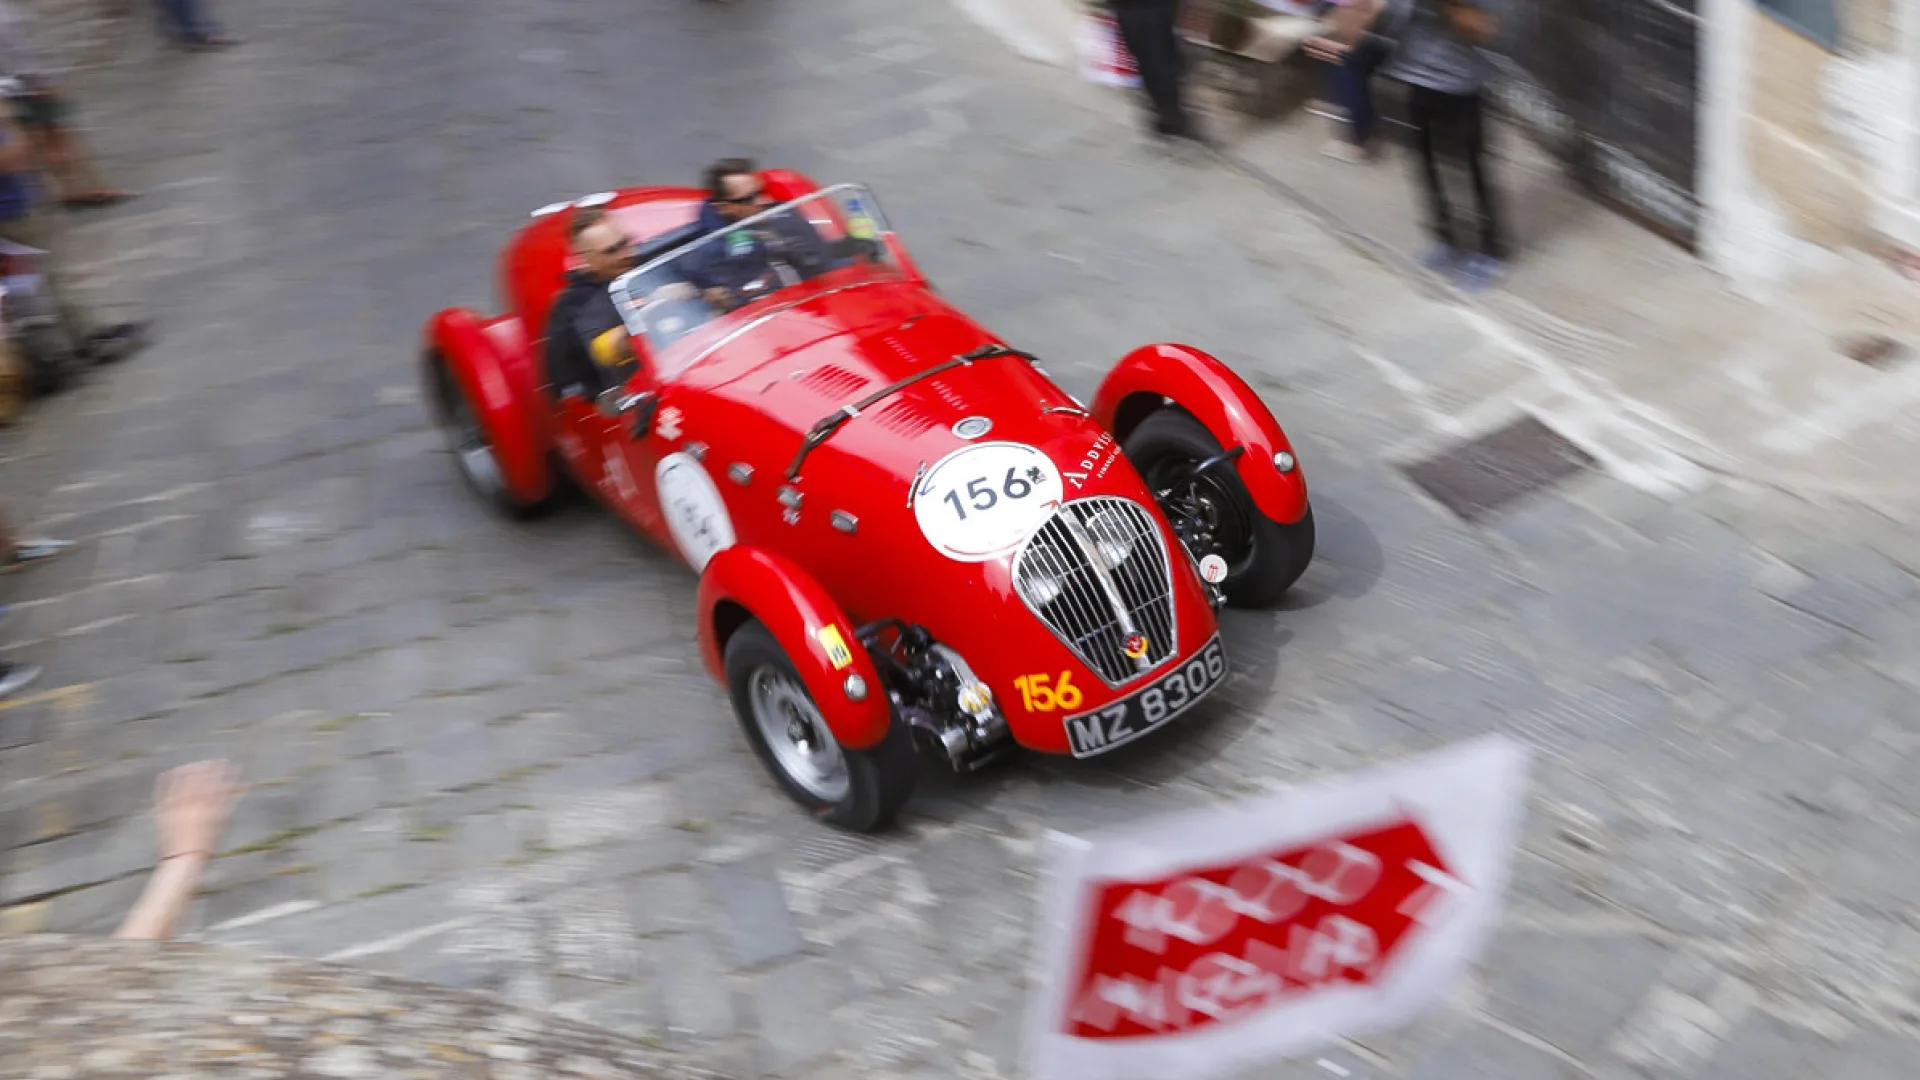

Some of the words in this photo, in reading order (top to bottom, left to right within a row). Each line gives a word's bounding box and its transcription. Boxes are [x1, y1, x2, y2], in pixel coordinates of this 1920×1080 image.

[943, 467, 1032, 520] 156
[1013, 670, 1083, 713] 156
[1072, 703, 1134, 751] MZ
[1140, 644, 1224, 723] 8306
